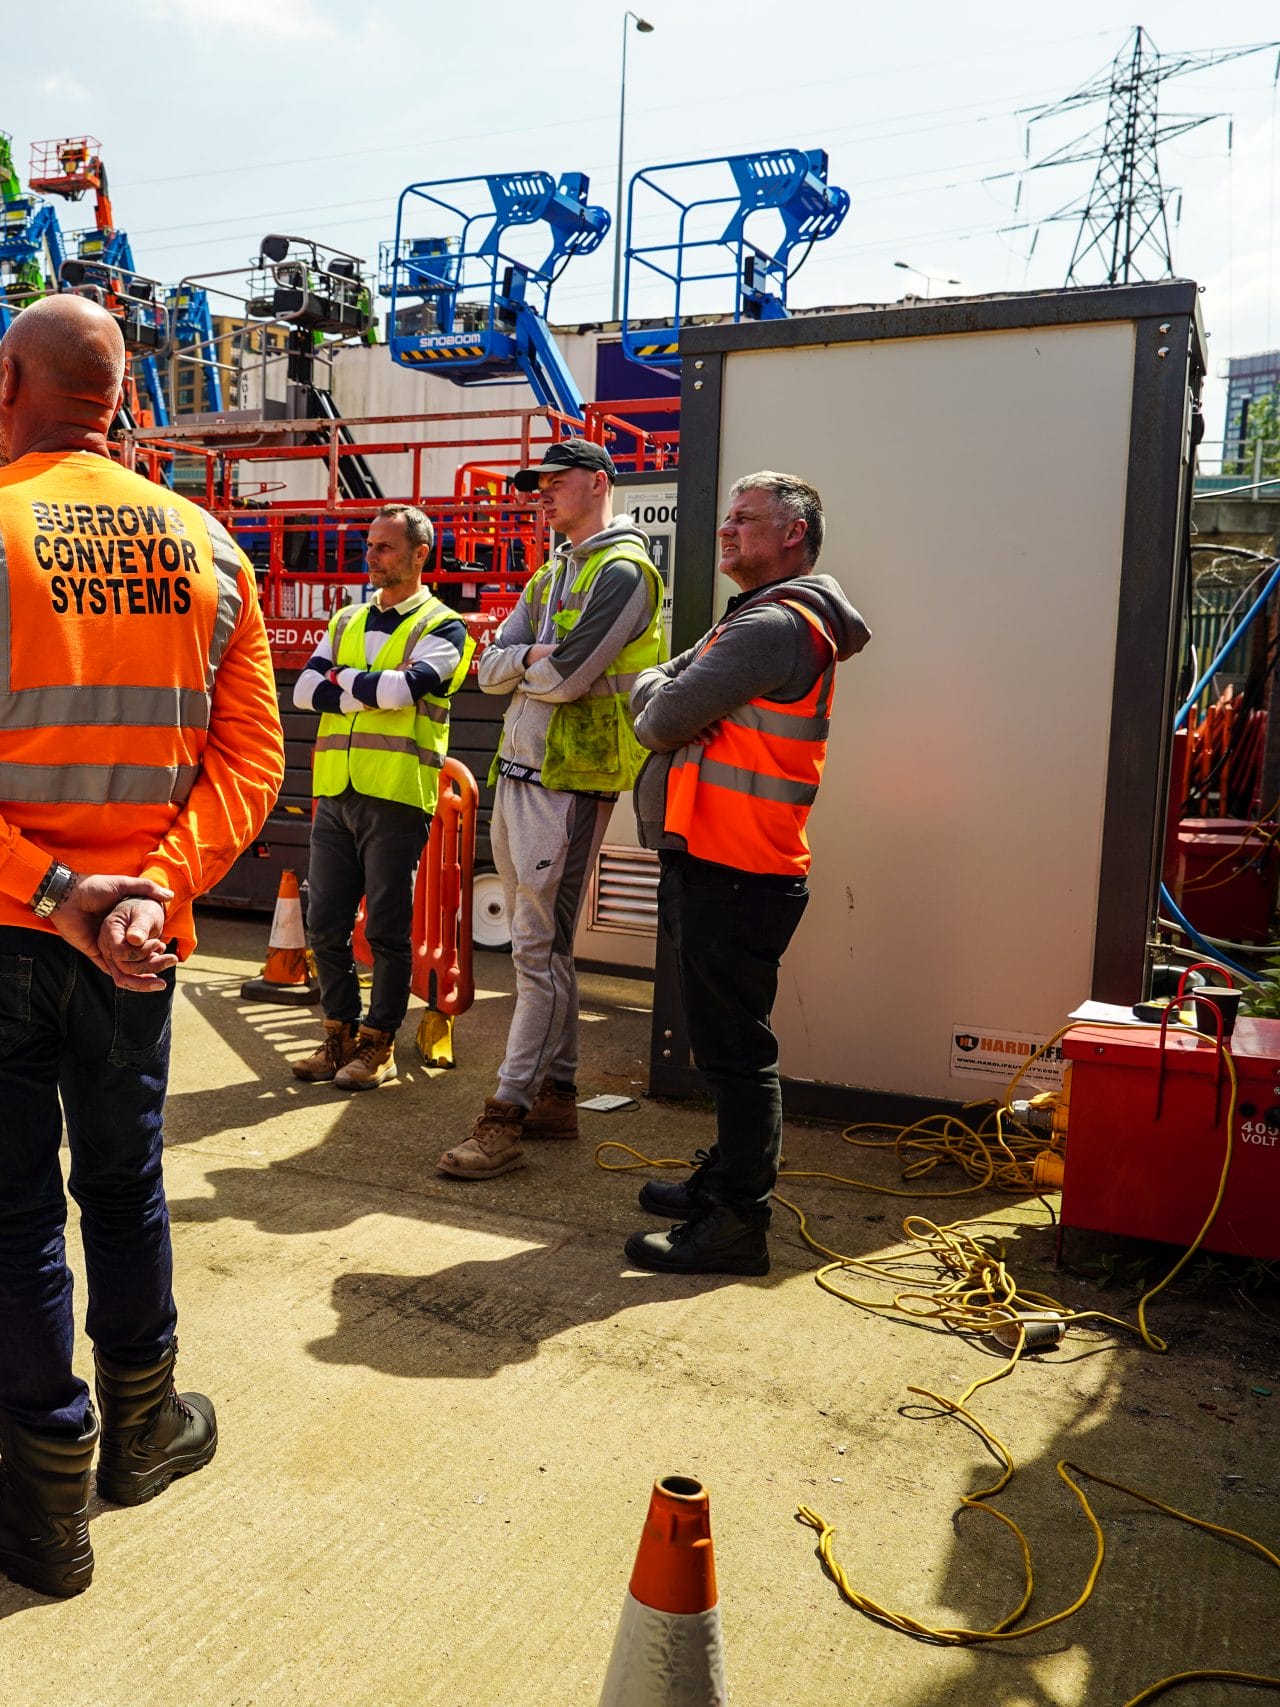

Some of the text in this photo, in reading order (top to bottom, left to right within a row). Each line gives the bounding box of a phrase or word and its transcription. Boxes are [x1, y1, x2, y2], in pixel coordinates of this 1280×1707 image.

[419, 333, 481, 348] SINOBOOM
[31, 501, 186, 536] BURROWS
[34, 535, 200, 574] CONVEYOR
[51, 575, 191, 615] SYSTEMS
[1241, 1132, 1279, 1147] VOLT
